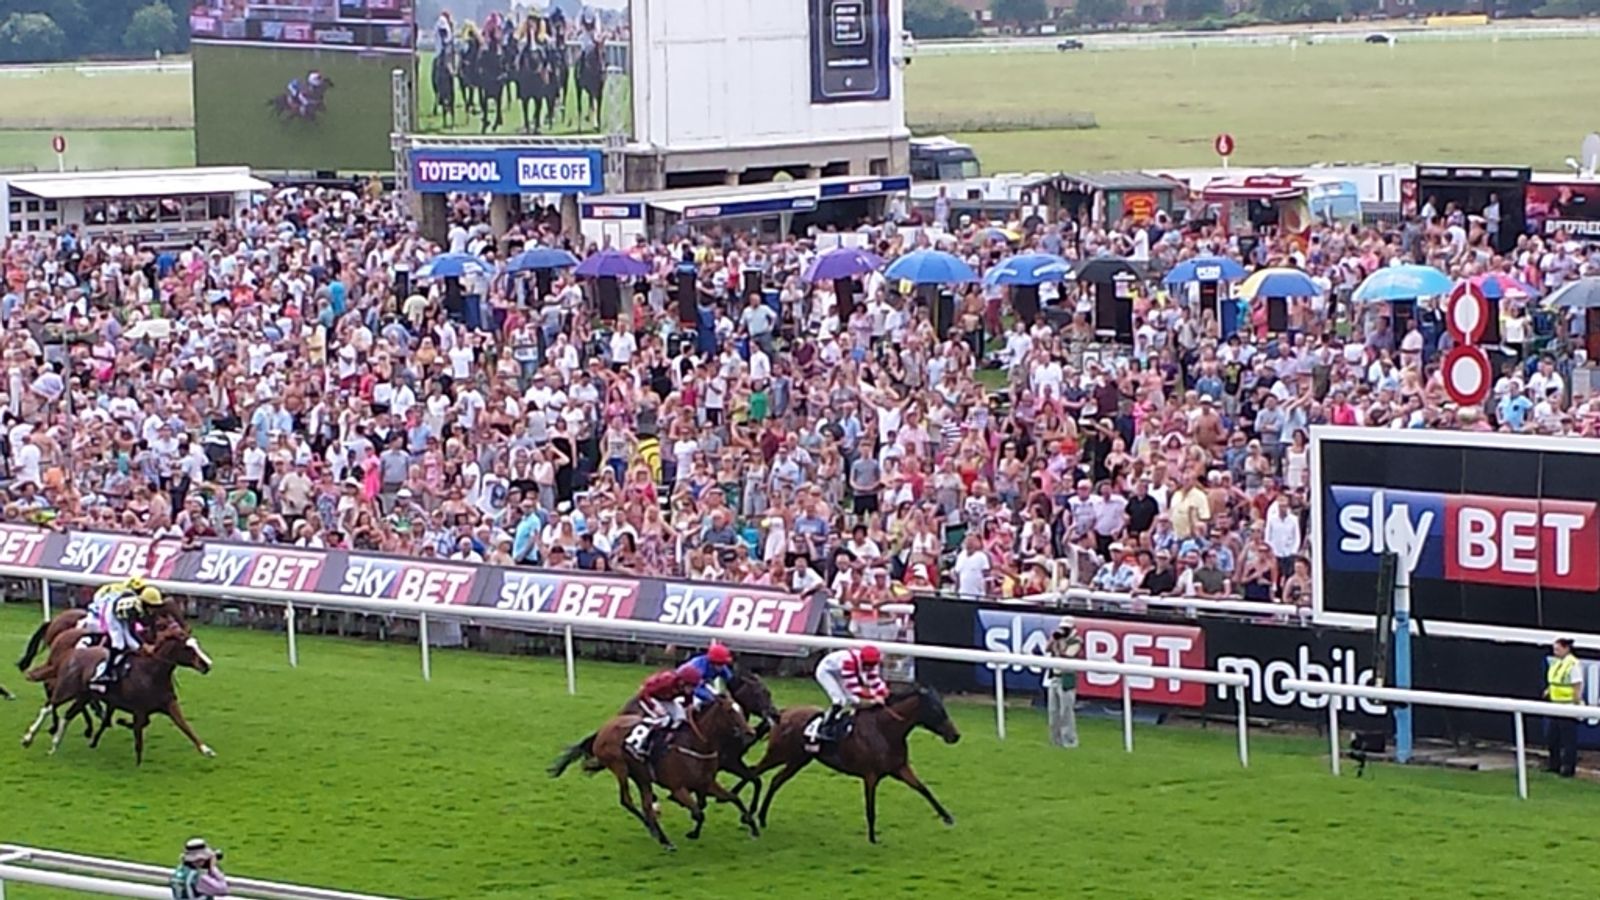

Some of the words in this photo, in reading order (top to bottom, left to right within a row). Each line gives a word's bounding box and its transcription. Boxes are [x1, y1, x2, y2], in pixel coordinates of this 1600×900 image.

[419, 161, 500, 181] TOTEPOOL
[522, 162, 558, 180] RACE
[560, 163, 587, 180] OFF
[60, 535, 111, 573] sky
[109, 543, 178, 577] BET
[1458, 507, 1585, 576] BET
[195, 547, 250, 587] sky
[249, 554, 320, 593] BET
[339, 558, 396, 598] sky
[400, 568, 471, 606] BET
[496, 574, 554, 614] sky
[555, 582, 633, 620] BET
[658, 588, 721, 628] sky
[722, 596, 806, 635] BET
[1085, 630, 1193, 693] BET
[803, 716, 823, 743] 4
